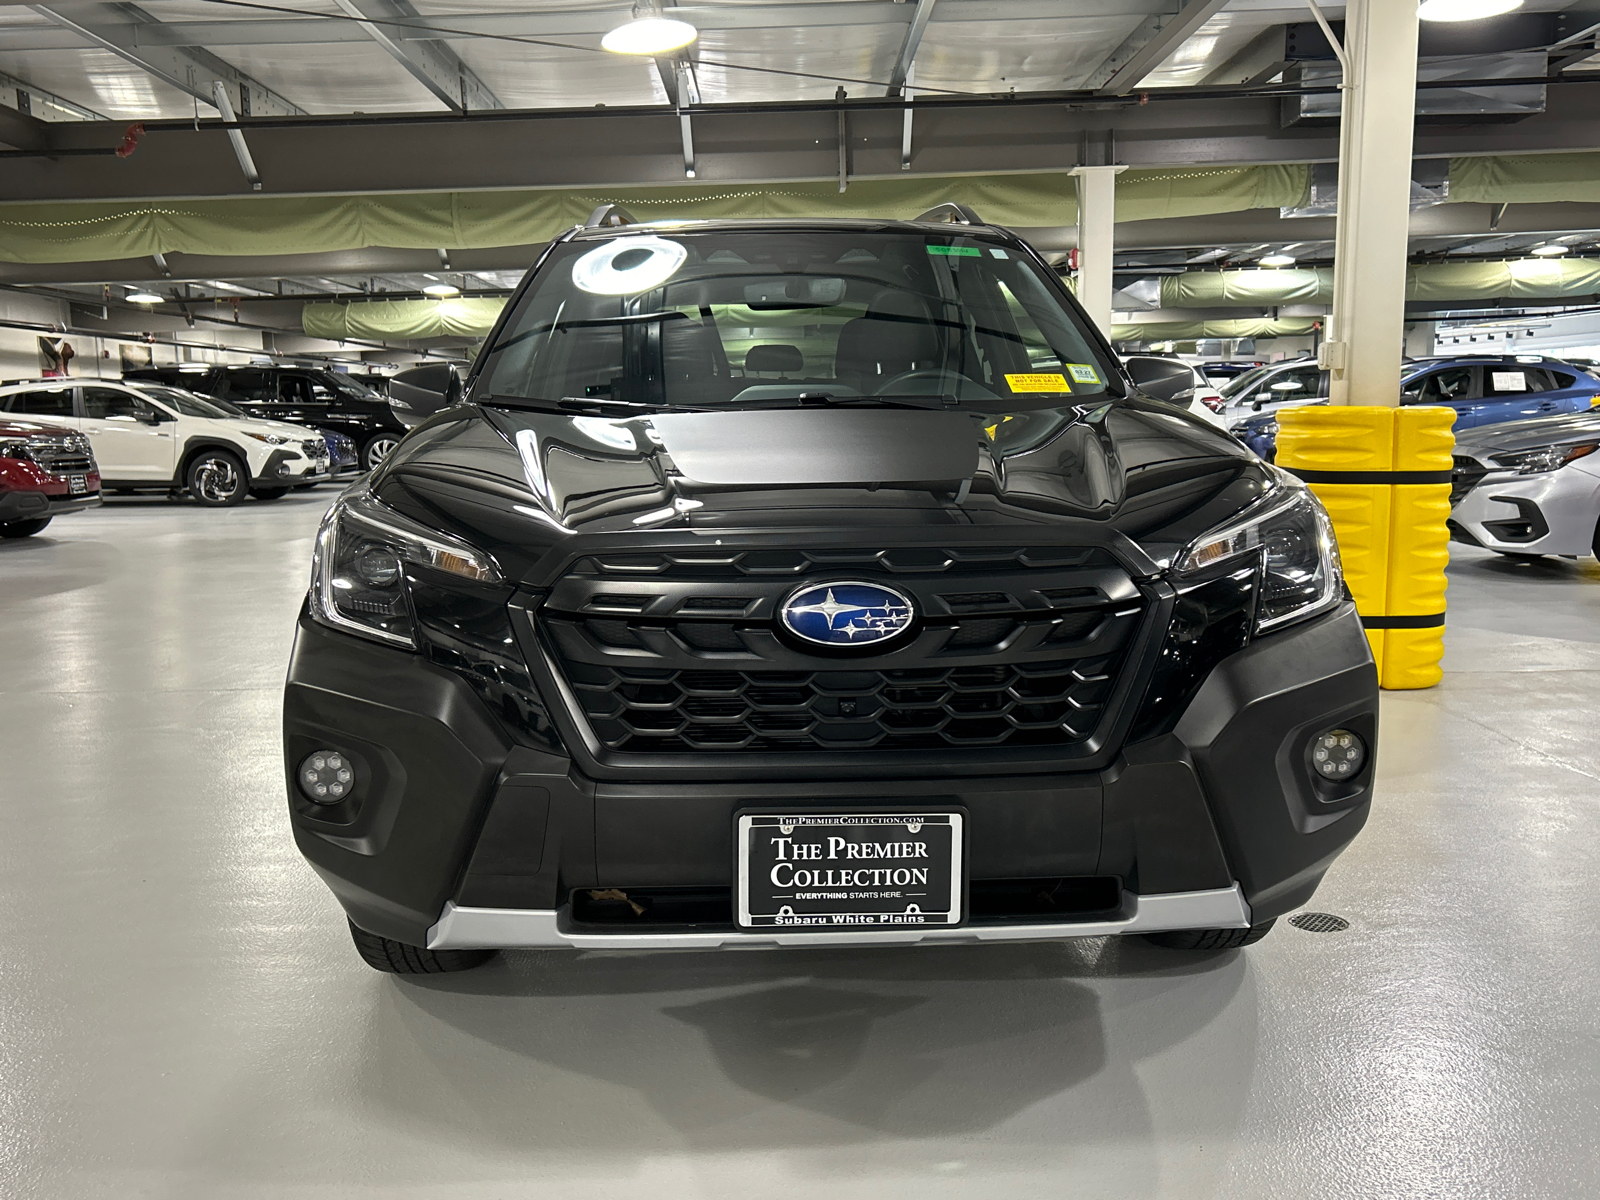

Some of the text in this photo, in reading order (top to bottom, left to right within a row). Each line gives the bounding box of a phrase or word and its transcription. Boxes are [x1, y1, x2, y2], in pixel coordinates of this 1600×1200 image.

[770, 836, 929, 861] THE PREMIER
[770, 862, 929, 888] COLLECTION
[795, 891, 904, 900] EVERYTHING STARTS HERE.
[775, 914, 925, 925] Subaru White Plains
